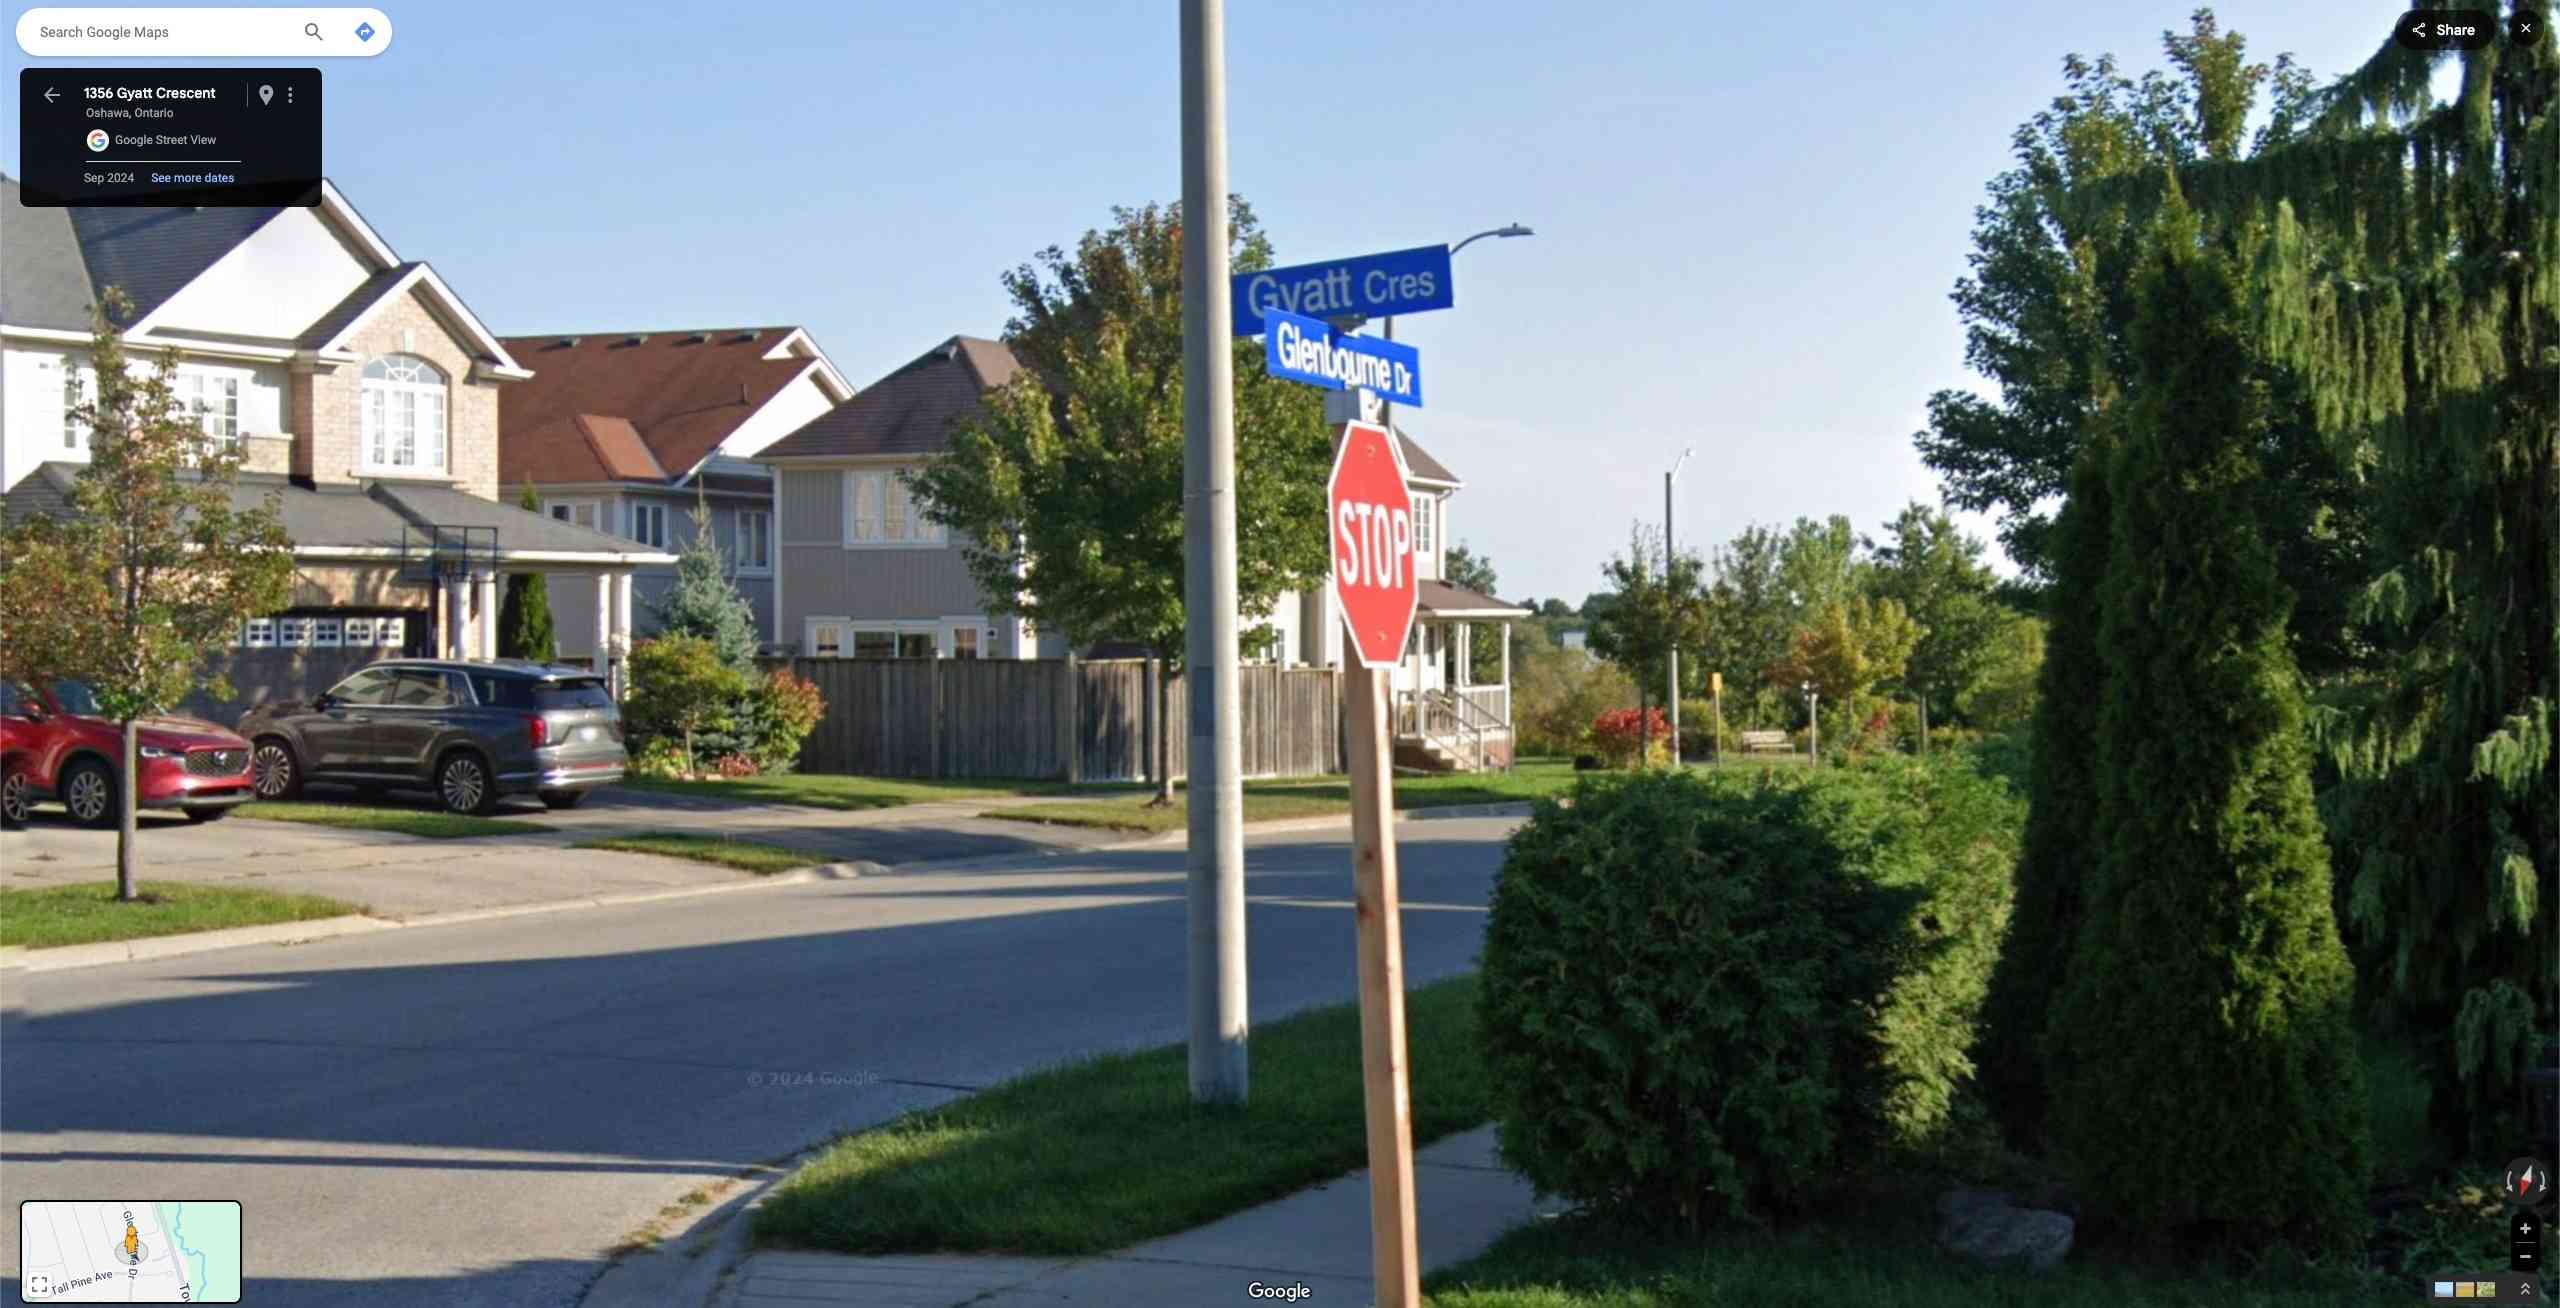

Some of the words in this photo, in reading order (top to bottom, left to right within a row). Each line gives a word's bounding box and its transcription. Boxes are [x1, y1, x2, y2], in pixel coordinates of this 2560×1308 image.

[1248, 267, 1353, 319] Gyatt
[1363, 270, 1435, 304] Cres
[1394, 362, 1411, 395] Dr
[1338, 499, 1410, 589] STOP
